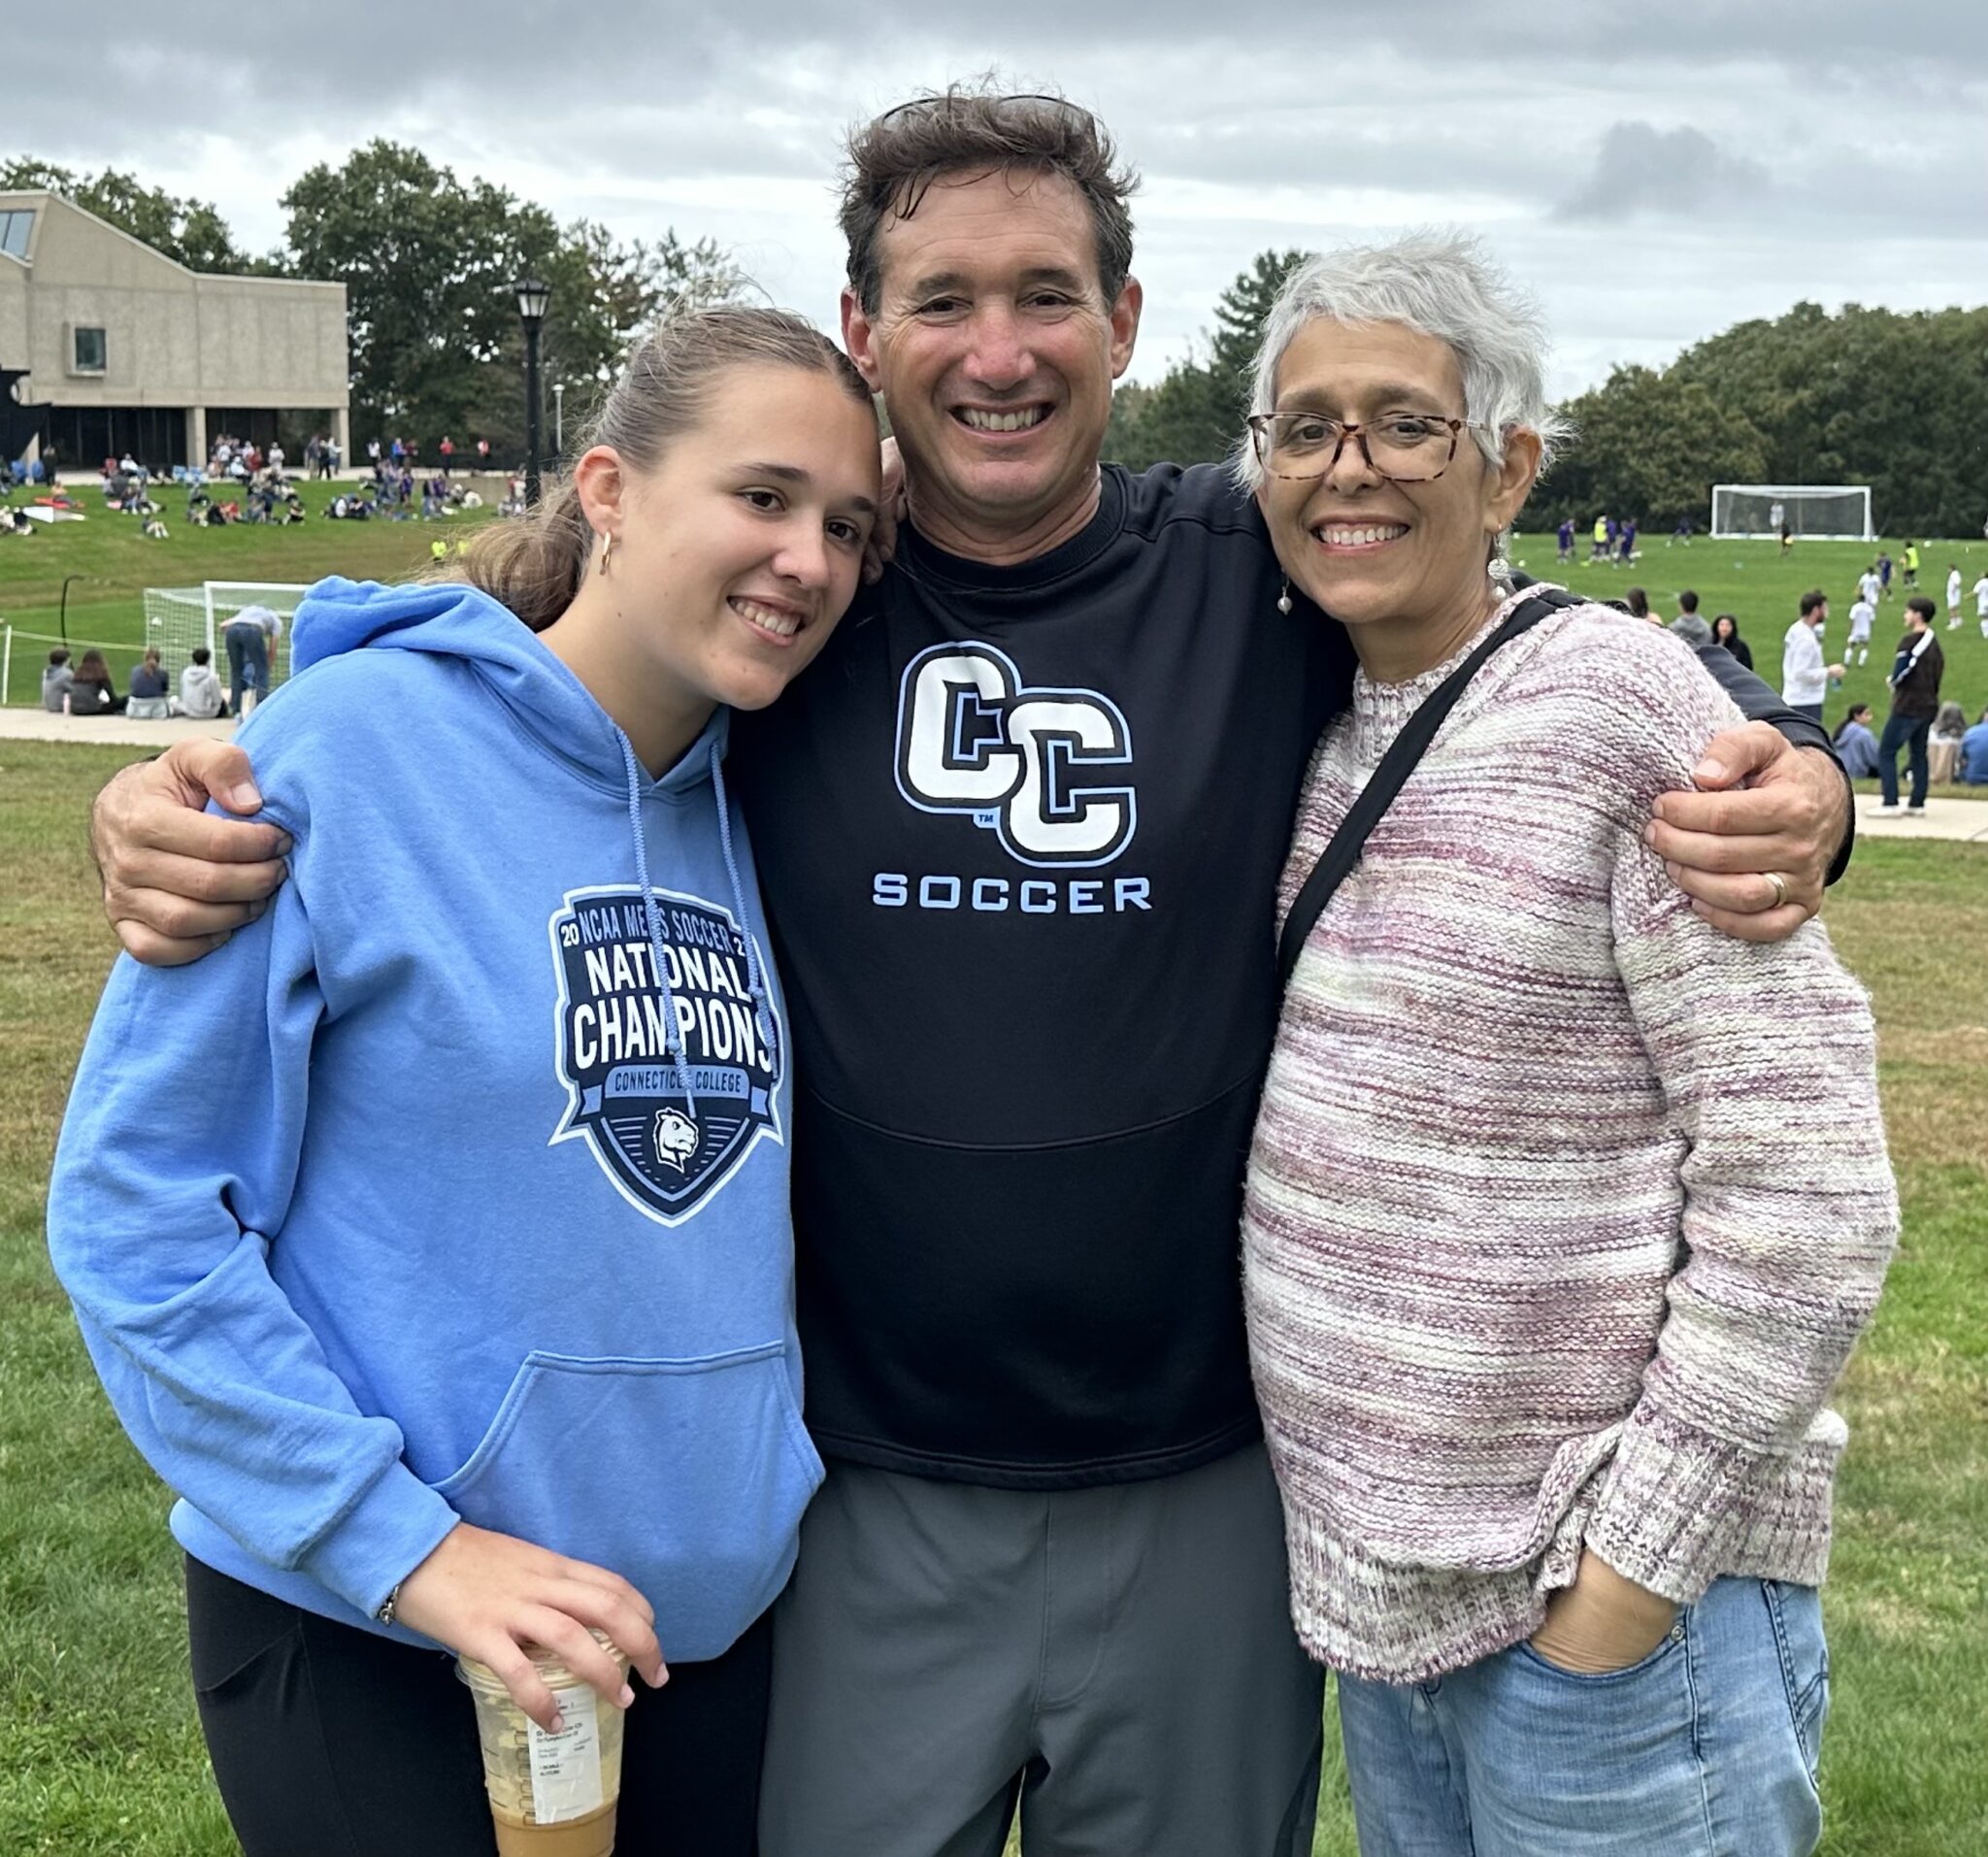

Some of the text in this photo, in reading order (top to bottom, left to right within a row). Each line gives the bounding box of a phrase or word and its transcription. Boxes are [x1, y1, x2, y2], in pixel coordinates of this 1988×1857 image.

[894, 641, 1137, 868] CC
[978, 813, 995, 823] TM
[873, 873, 1153, 914] SOCCER
[560, 923, 580, 947] 20
[578, 905, 735, 955] NCAA MES SOCCER
[733, 936, 749, 958] 2
[614, 1070, 742, 1094] CONNECTIC COLLEGE
